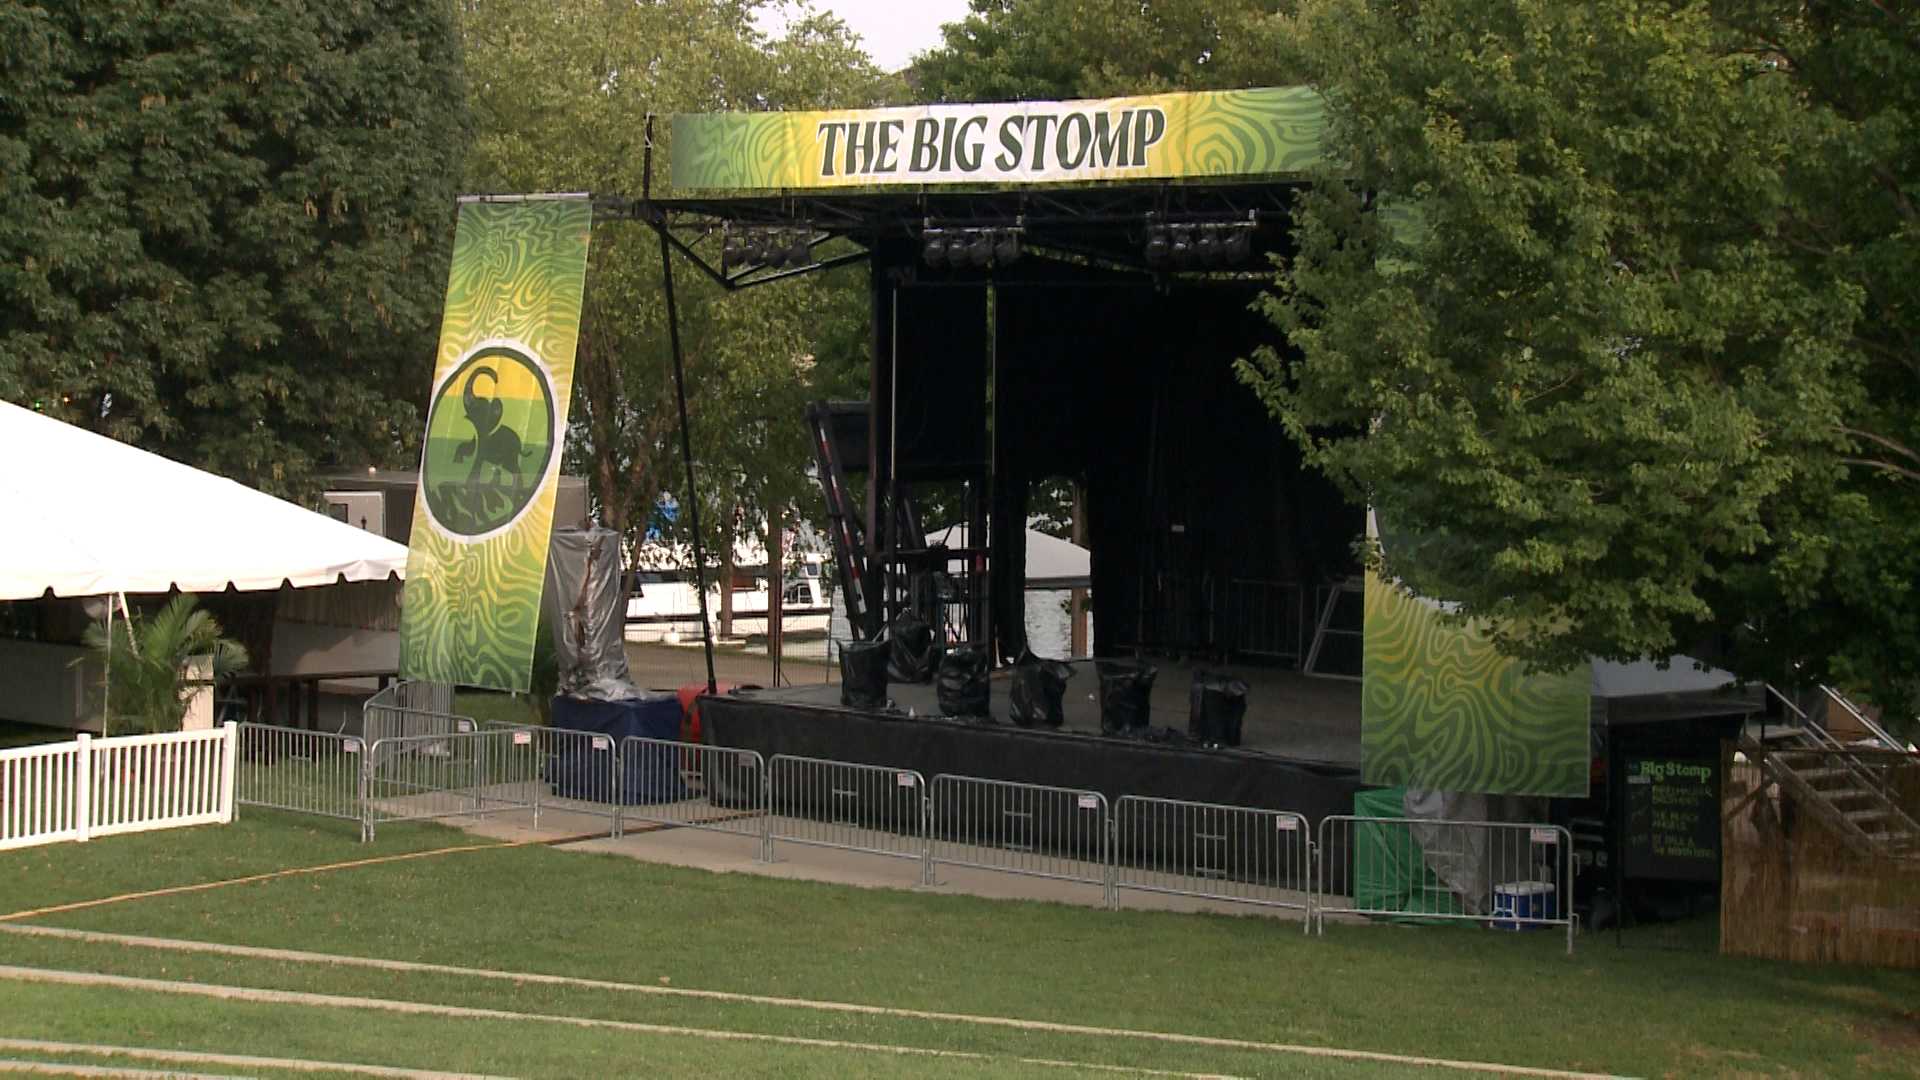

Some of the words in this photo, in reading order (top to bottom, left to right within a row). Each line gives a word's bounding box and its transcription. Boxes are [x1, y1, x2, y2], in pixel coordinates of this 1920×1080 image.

[817, 120, 904, 176] THE
[909, 116, 988, 172] BIG
[994, 109, 1165, 172] STOMP
[1665, 761, 1711, 784] Stomp
